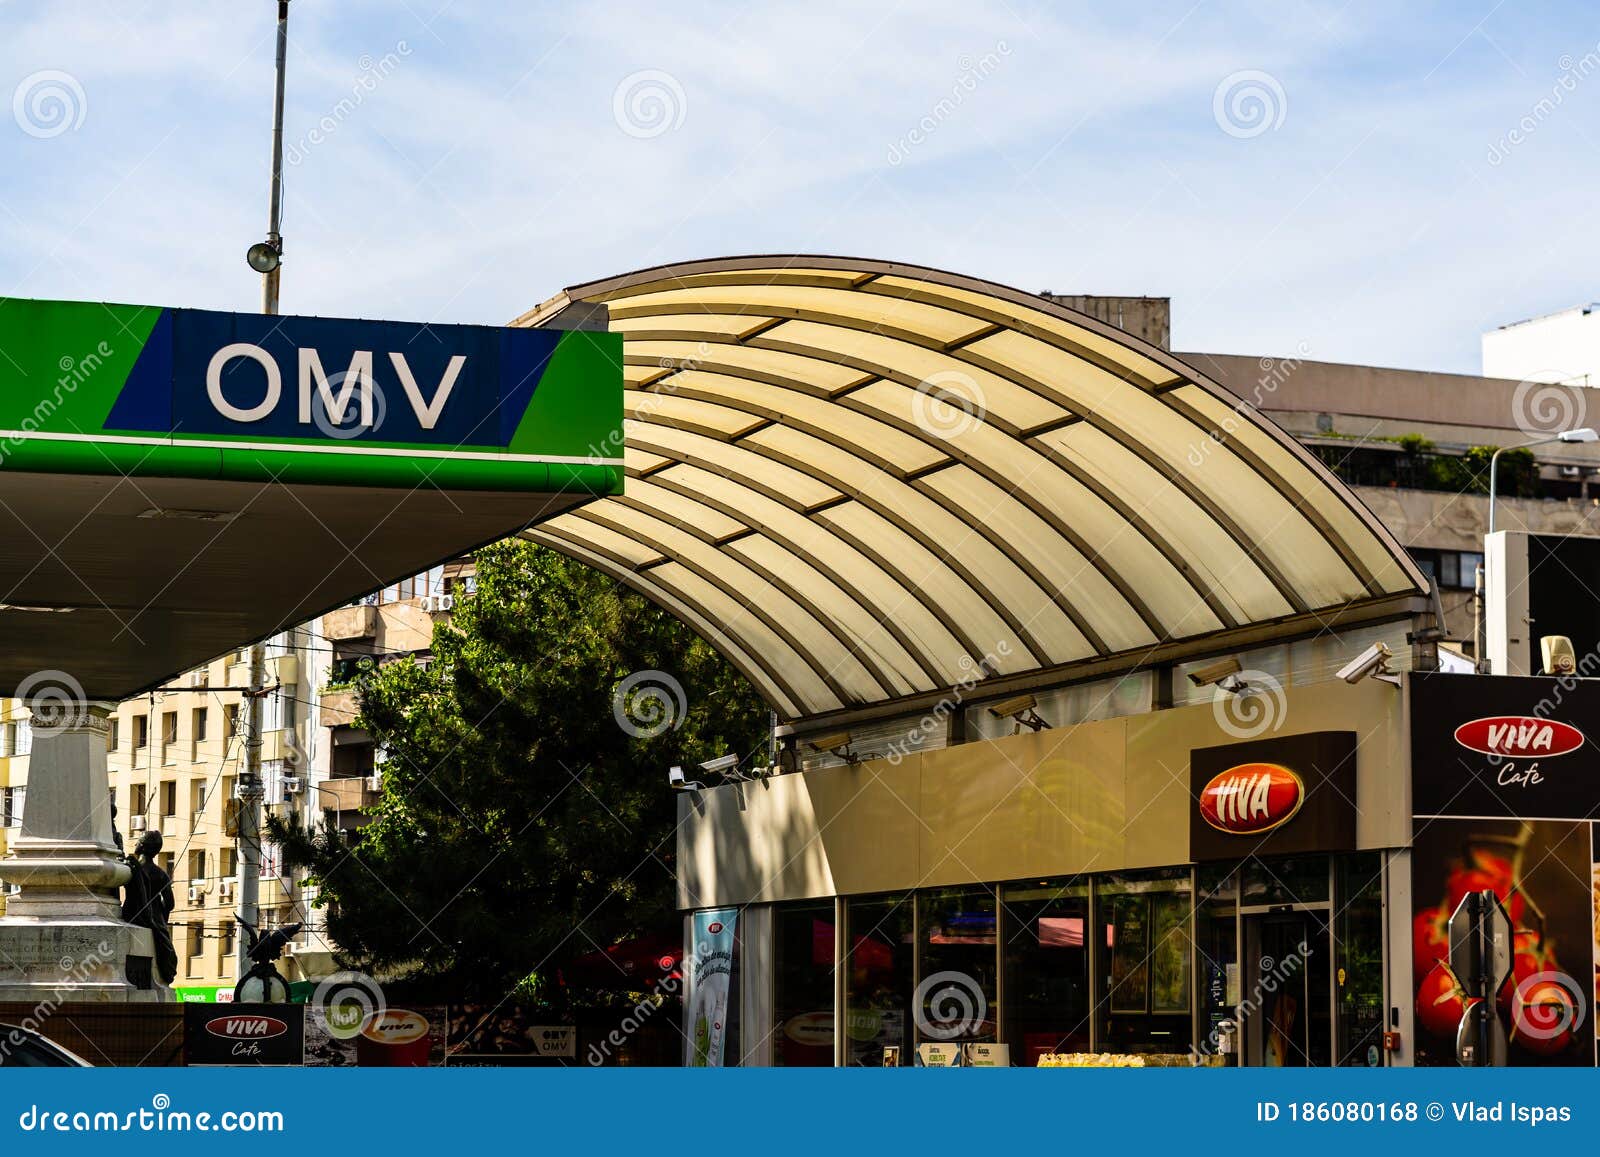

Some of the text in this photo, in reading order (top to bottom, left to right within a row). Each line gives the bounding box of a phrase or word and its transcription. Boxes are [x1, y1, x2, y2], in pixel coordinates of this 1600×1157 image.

[206, 342, 467, 430] OMV
[1487, 723, 1554, 750] VIVA
[1216, 773, 1271, 823] VIVA
[226, 1020, 268, 1035] VIVA
[543, 1042, 567, 1050] OMV
